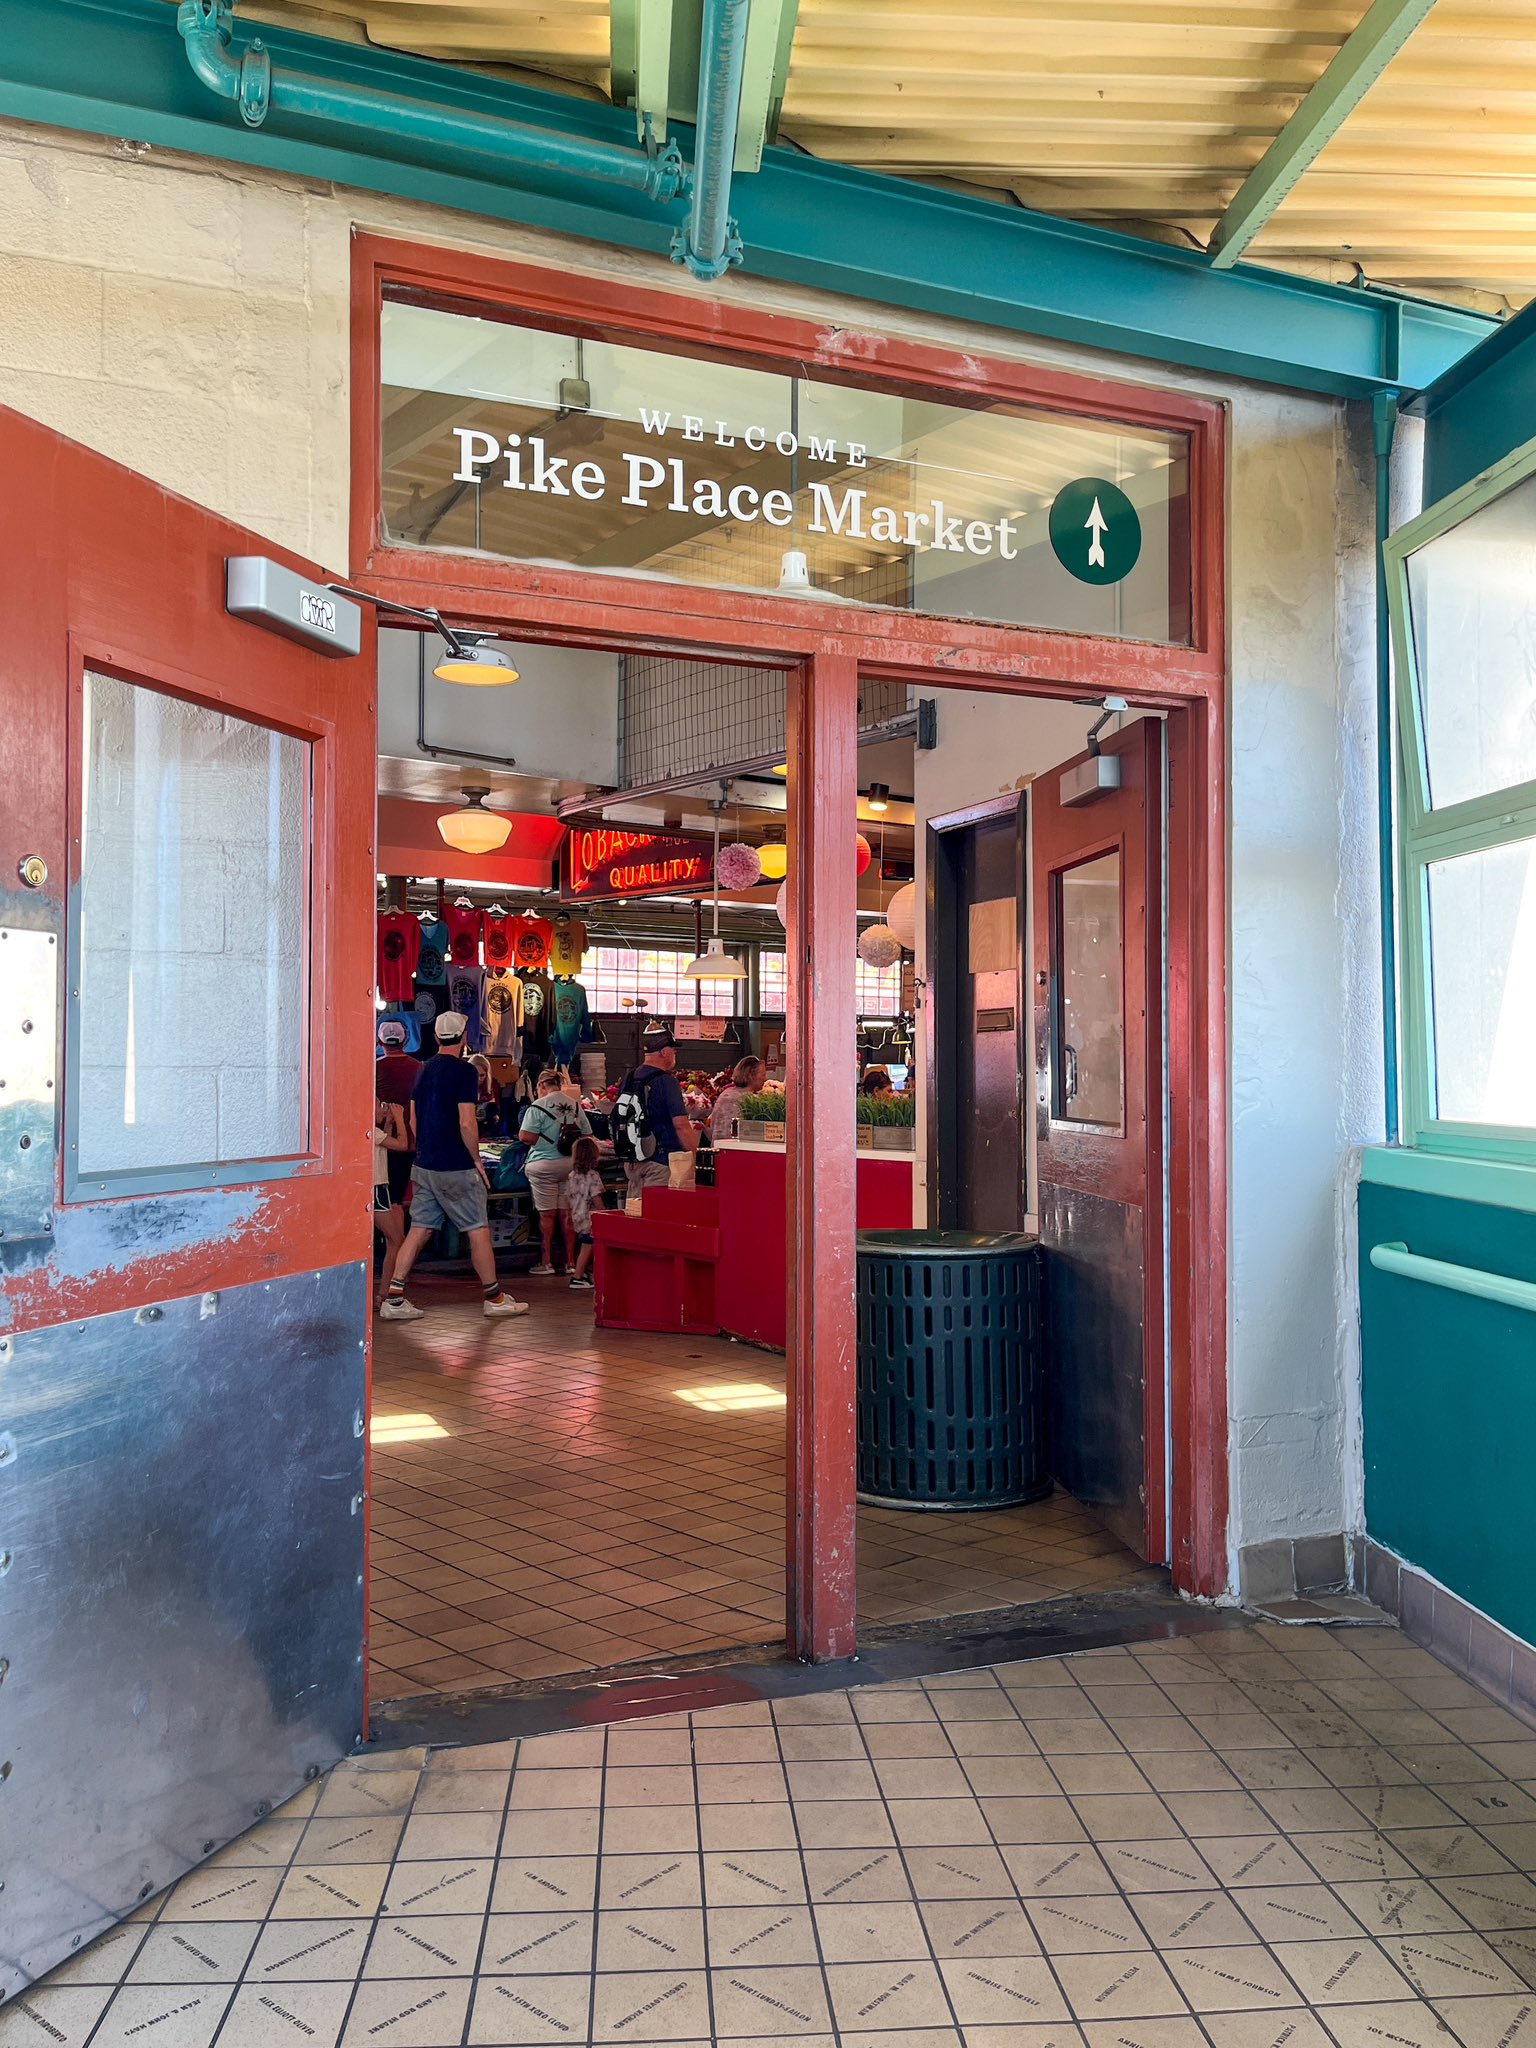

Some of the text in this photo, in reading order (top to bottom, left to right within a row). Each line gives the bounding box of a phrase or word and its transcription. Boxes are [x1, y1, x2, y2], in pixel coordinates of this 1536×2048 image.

[639, 406, 869, 470] WELCOME
[451, 427, 1019, 562] Pike Place Market
[610, 858, 696, 889] QUALITY
[1472, 1797, 1508, 1809] 16
[722, 1863, 739, 1871] JOHN
[1169, 1868, 1197, 1880] BROWN
[445, 1868, 477, 1884] DEBORAH
[524, 1872, 567, 1896] SAM ANDERSON
[237, 1879, 257, 1890] MARY
[304, 1875, 321, 1883] MARY
[334, 1892, 348, 1900] BEST
[345, 1899, 360, 1908] MOM
[1043, 1907, 1067, 1918] HAPPY
[171, 1936, 220, 1969] HEIDI LOVES HARRIS
[393, 1926, 407, 1935] ROY
[432, 1950, 457, 1965] DUNBAR
[647, 1937, 662, 1945] AND
[661, 1943, 677, 1953] DAN
[1403, 1947, 1423, 1955] JEFF
[1472, 1969, 1499, 1981] ROCK!
[896, 1973, 916, 1986] HILDA
[1122, 1966, 1140, 1979] PETER
[1183, 1959, 1205, 1970] ALICE
[1214, 1970, 1240, 1983] EMMA
[1242, 1981, 1281, 1997] JOHNSON
[730, 1979, 758, 1995] ROBERT
[967, 1972, 1040, 2006] SURPRISE YOURSELF
[1095, 1983, 1119, 2002] JOHNSON
[180, 1999, 201, 2010] JEAN
[416, 1998, 432, 2008] AND
[495, 1986, 514, 1998] POPO
[529, 2006, 549, 2019] XOXO
[547, 2018, 569, 2031] CLOUD
[613, 1982, 687, 2029] CAROLE LOVES RICHARD
[147, 2013, 170, 2026] JOHN
[259, 1997, 315, 2035] ALEX ELLIOTT OLIVER
[398, 2008, 416, 2018] ROD
[124, 2024, 147, 2036] HAYS
[368, 2017, 399, 2034] HEARNE
[1367, 2026, 1383, 2035] JOE
